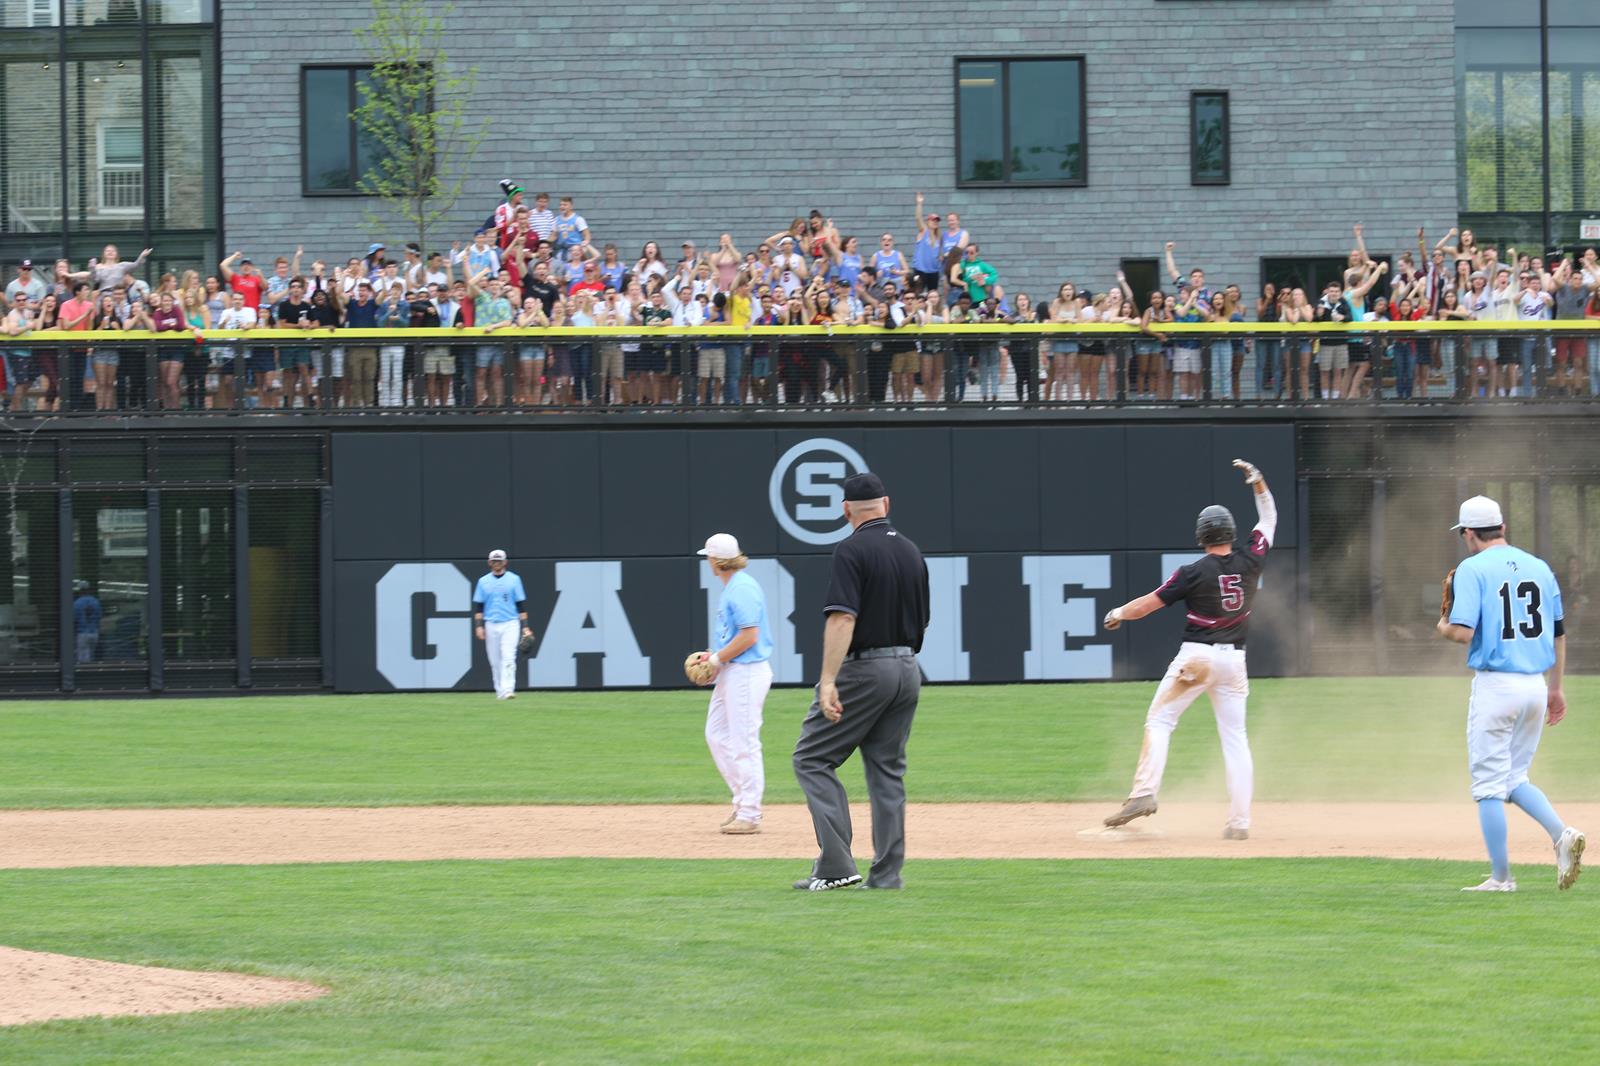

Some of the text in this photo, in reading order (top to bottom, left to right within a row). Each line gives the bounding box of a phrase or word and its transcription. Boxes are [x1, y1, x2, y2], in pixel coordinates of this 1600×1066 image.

[795, 462, 846, 520] S
[1218, 573, 1245, 612] 5
[1498, 580, 1543, 640] 13
